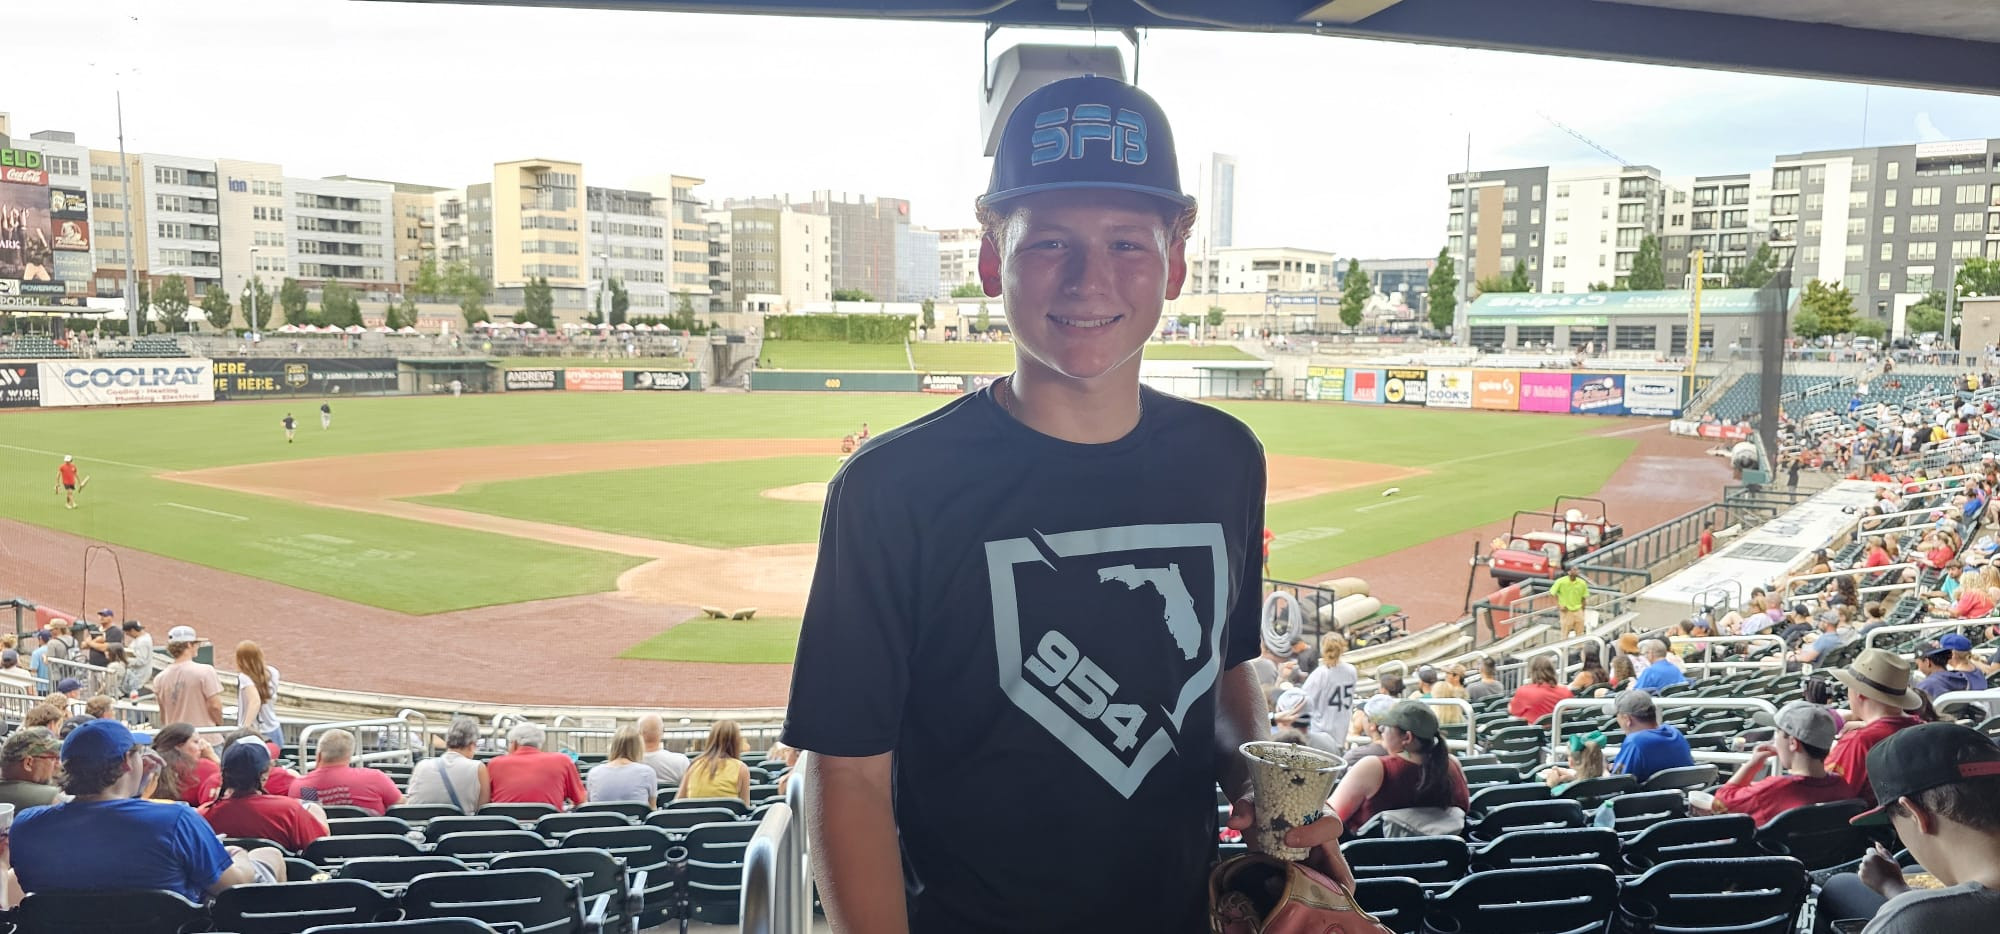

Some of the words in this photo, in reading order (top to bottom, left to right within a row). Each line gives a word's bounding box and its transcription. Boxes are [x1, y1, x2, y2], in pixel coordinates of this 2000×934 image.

[1032, 104, 1148, 167] SFB
[229, 175, 247, 192] ion
[64, 366, 206, 388] COOLRAY
[507, 371, 555, 381] ANDREWS
[106, 388, 140, 396] Cooling
[237, 379, 281, 391] HERE.
[8, 389, 39, 398] WIDE
[1429, 390, 1470, 400] COOK'S
[1023, 630, 1148, 752] 954
[1328, 684, 1354, 712] 45
